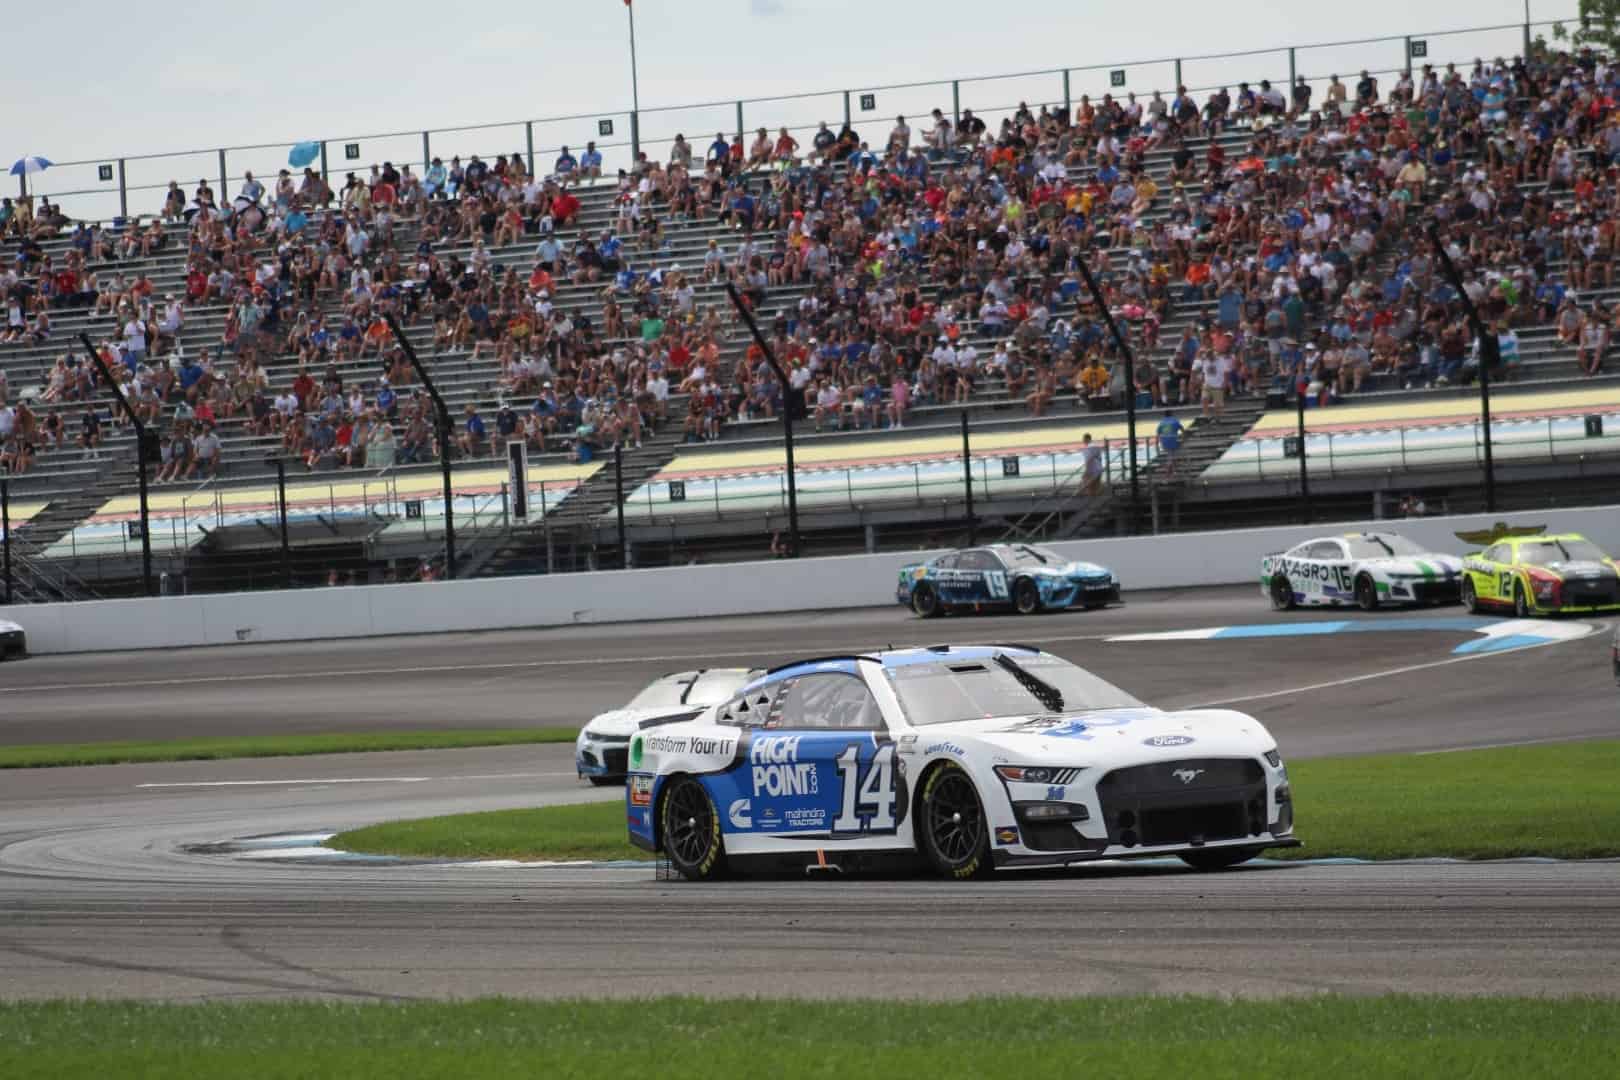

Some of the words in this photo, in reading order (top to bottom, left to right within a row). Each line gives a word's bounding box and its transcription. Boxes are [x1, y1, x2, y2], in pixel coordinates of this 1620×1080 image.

[983, 571, 1008, 597] 19
[1332, 565, 1353, 591] 16
[1499, 571, 1511, 598] 12
[689, 736, 717, 754] Your
[719, 738, 734, 754] IT
[751, 736, 800, 764] HIGH
[752, 764, 810, 797] POINT
[833, 743, 896, 831] 14
